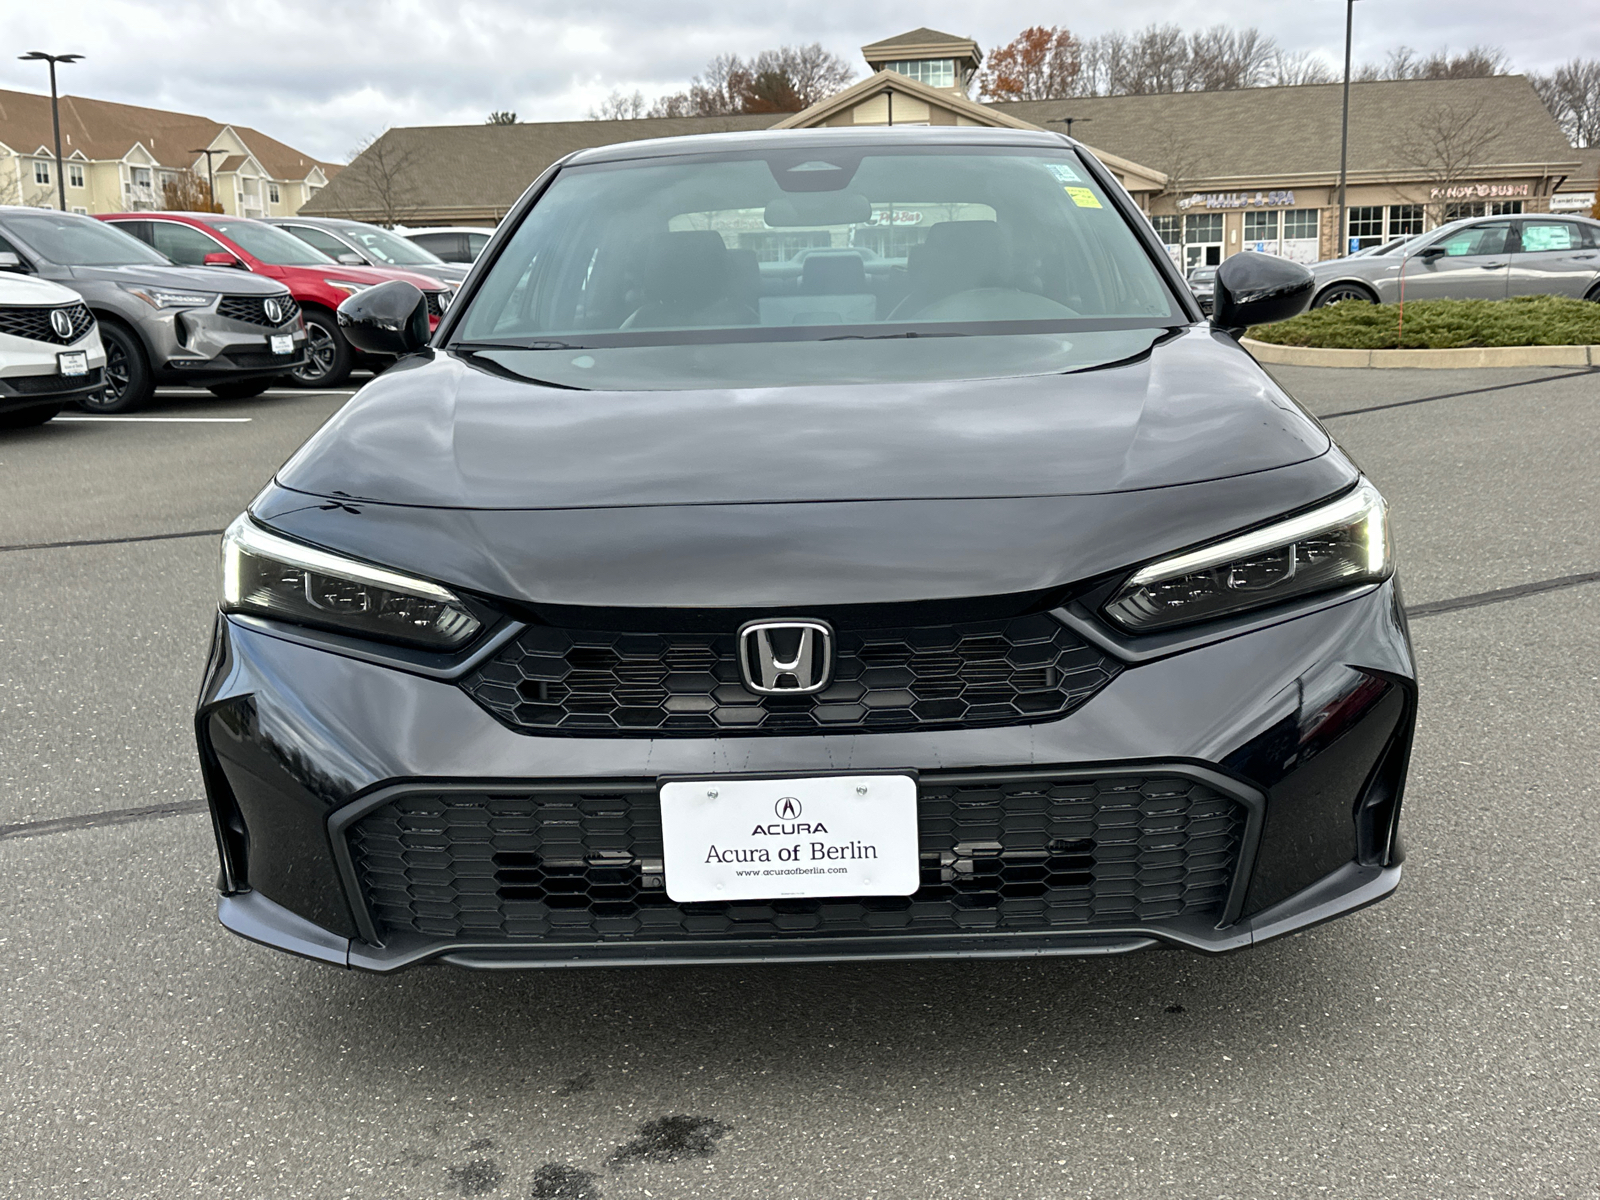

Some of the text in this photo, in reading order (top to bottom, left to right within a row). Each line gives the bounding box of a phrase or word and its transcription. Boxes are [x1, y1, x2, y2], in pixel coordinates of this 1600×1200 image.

[1206, 193, 1249, 208] NAILS
[1254, 191, 1264, 206] &
[1268, 190, 1295, 206] SPA
[900, 210, 921, 222] Bar
[751, 822, 829, 836] ACURA
[704, 841, 878, 864] Acura of Berlin
[736, 866, 848, 877] www.acuraofberlin.com
